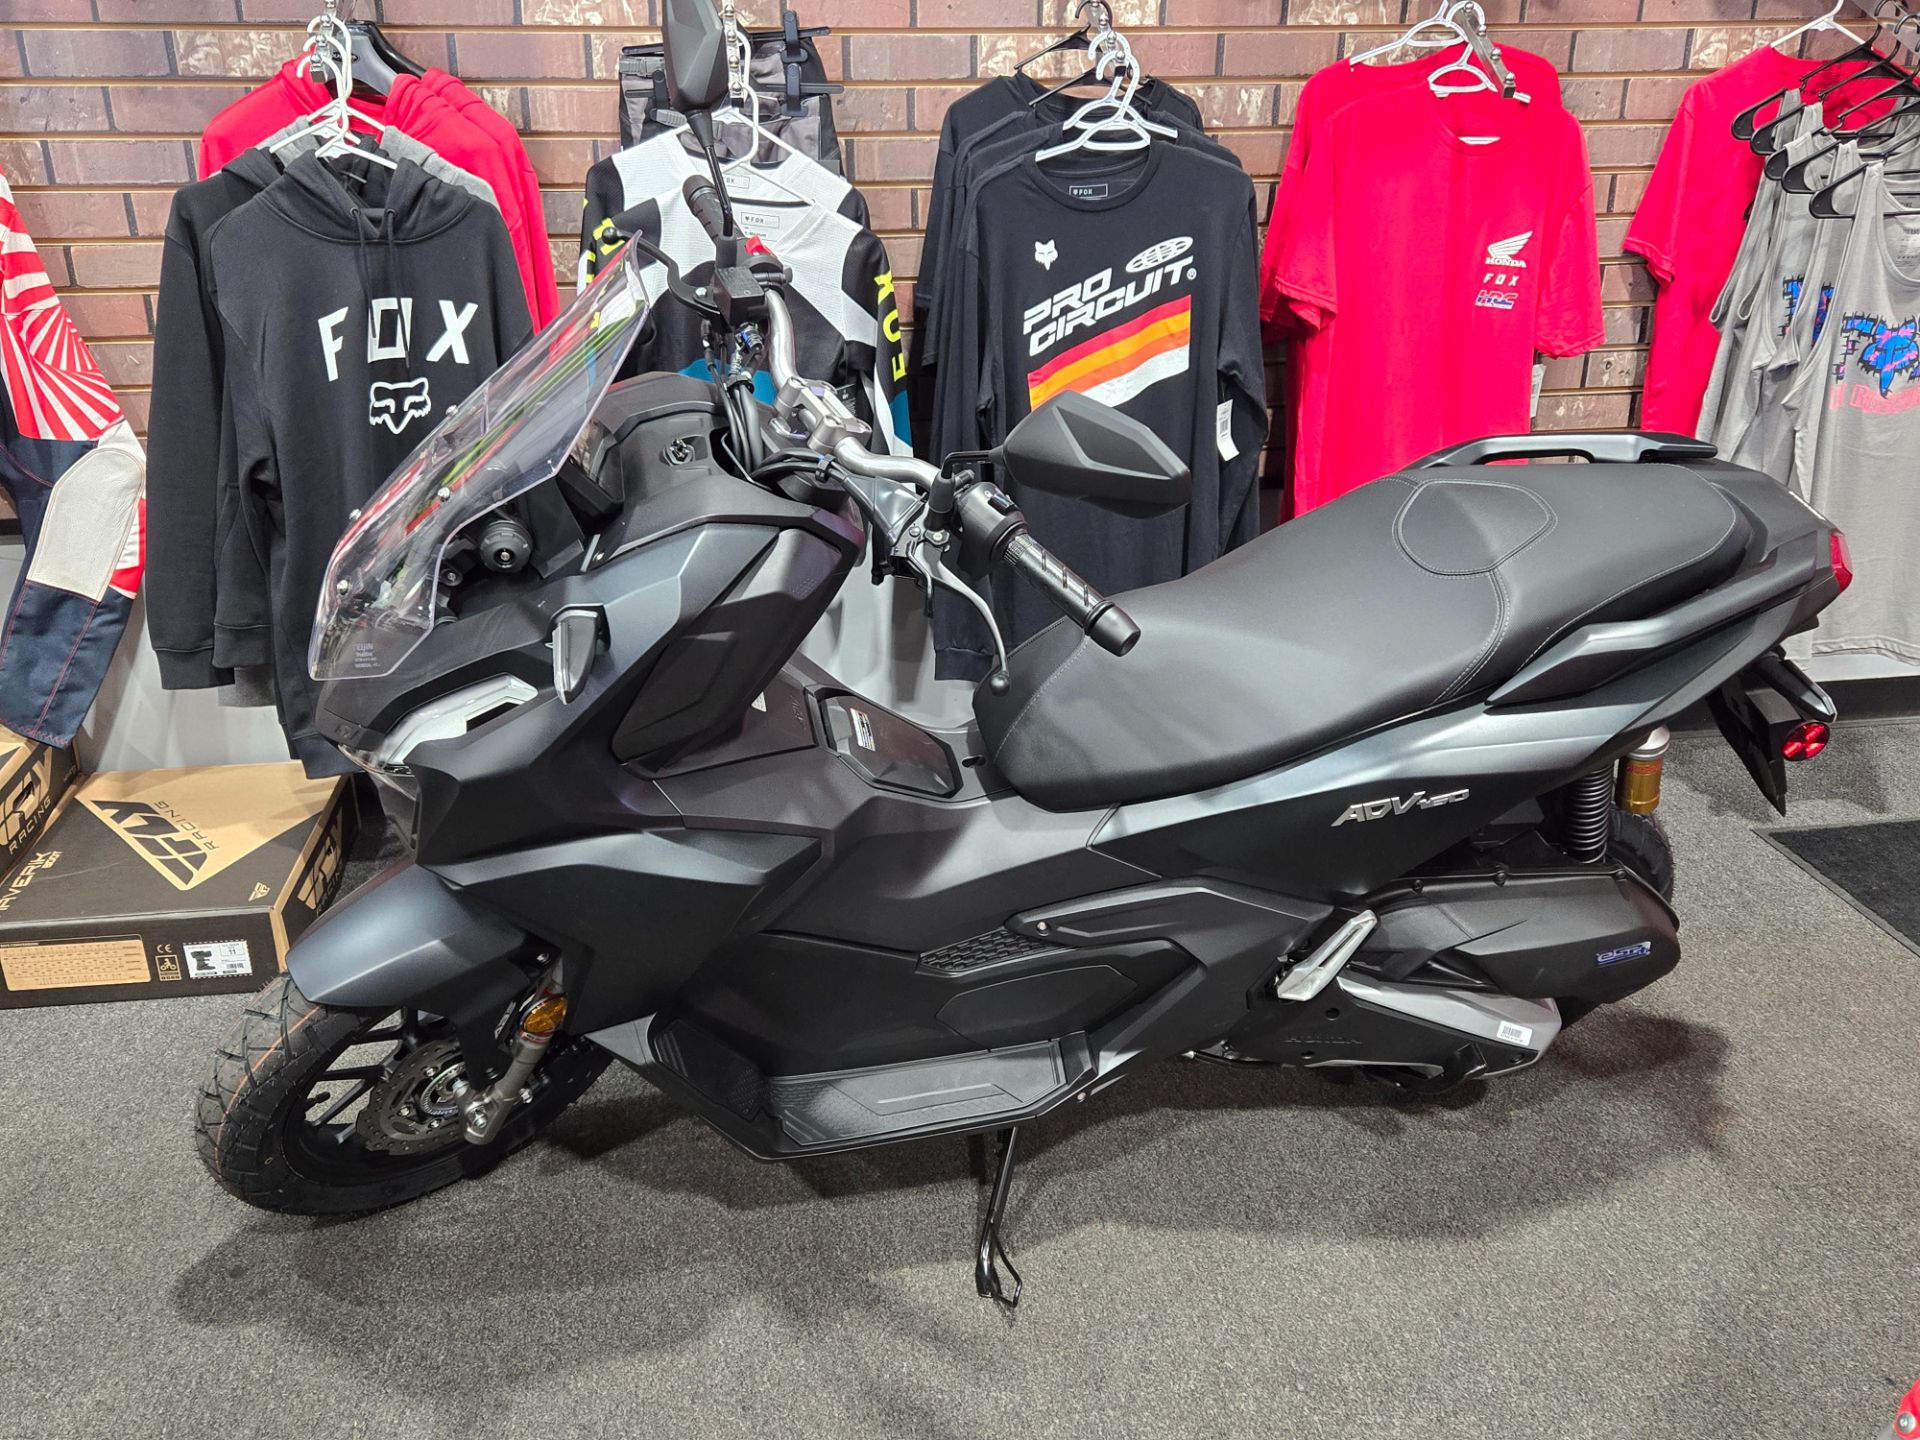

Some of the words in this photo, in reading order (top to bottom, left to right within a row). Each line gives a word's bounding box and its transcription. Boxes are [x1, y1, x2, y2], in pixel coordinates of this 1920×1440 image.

[1078, 187, 1094, 196] FOX
[1483, 273, 1519, 287] FOX
[1485, 256, 1527, 268] HONDA
[1023, 267, 1113, 335] PRO
[1029, 255, 1194, 357] CIRCUIT
[318, 297, 479, 382] FOX
[9, 796, 51, 855] RACING
[154, 800, 219, 850] RACING
[156, 943, 173, 954] CE
